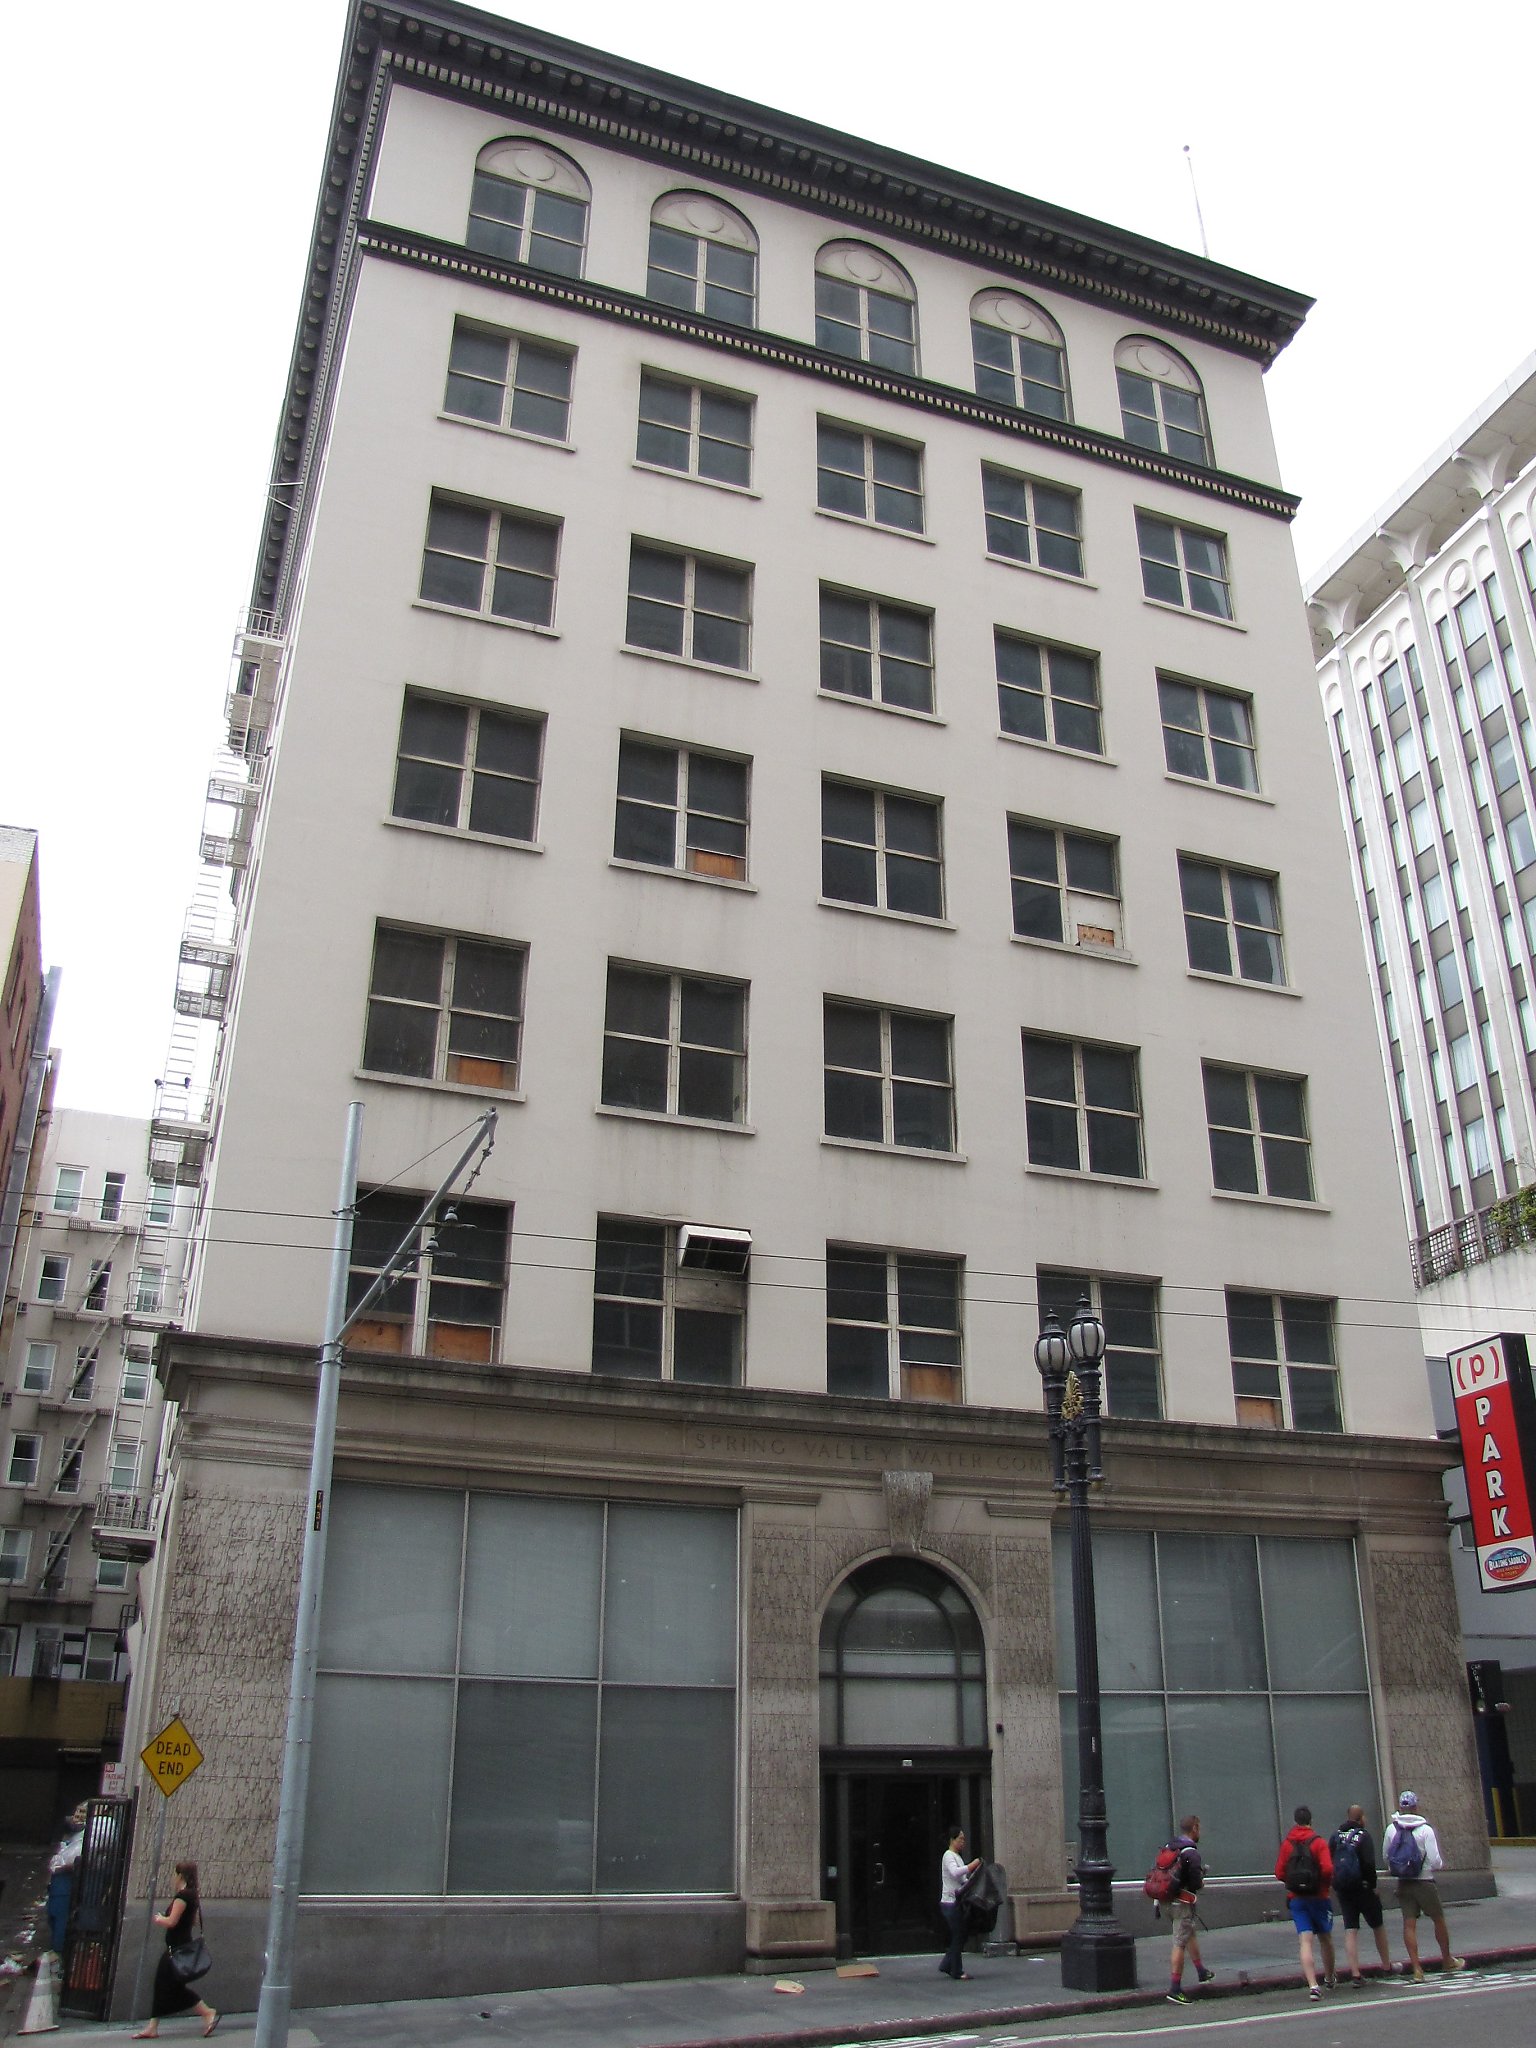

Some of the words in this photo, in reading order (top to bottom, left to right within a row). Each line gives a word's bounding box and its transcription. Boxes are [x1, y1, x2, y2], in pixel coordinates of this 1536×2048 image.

[695, 1432, 785, 1455] SPRING
[803, 1441, 892, 1463] VALLEY
[908, 1449, 983, 1469] WATER
[1475, 1396, 1511, 1538] PARK
[156, 1741, 191, 1756] DEAD
[158, 1761, 184, 1776] END
